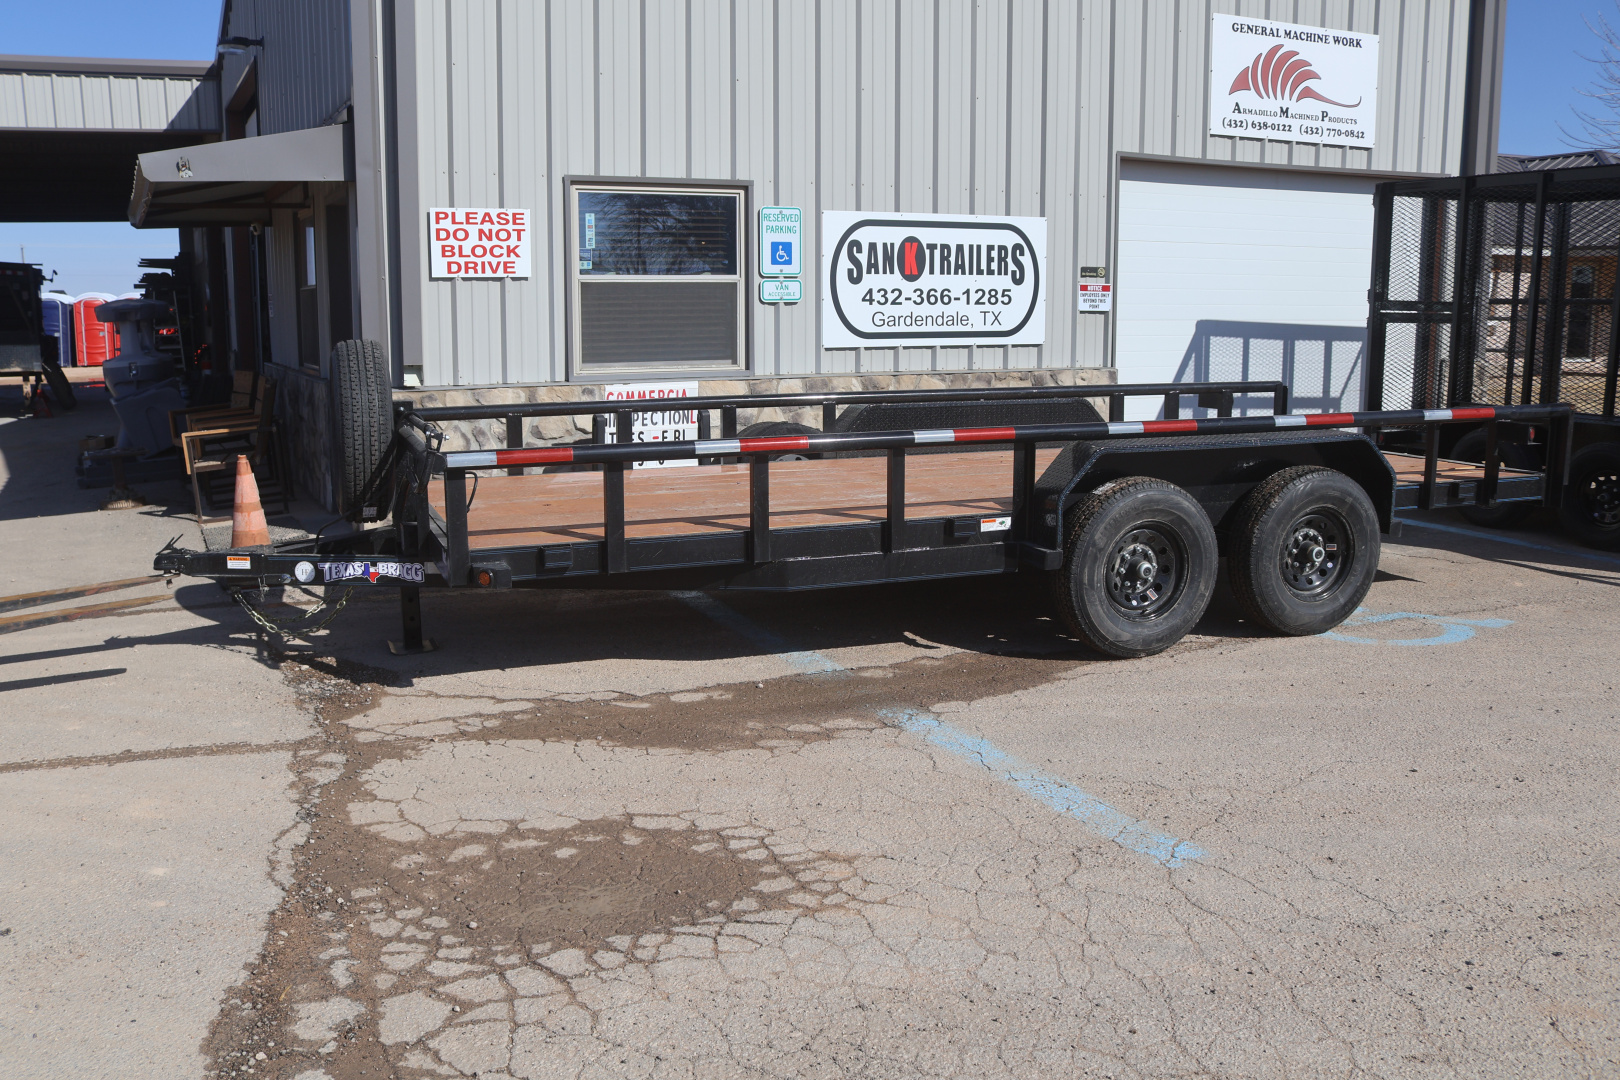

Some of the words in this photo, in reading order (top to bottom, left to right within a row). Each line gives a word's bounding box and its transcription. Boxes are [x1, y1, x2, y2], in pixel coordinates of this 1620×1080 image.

[1231, 22, 1282, 38] GENERAL
[1283, 30, 1330, 45] MACHINE
[1333, 36, 1363, 48] WORK
[1222, 117, 1249, 130] (432)
[1251, 121, 1293, 132] 638-0122
[1299, 124, 1324, 137] (432)
[1326, 128, 1365, 139] 770-0842
[434, 211, 526, 226] PLEASE
[763, 213, 800, 223] RESERVED
[435, 228, 470, 242] DO
[477, 228, 526, 242] NOT
[765, 225, 797, 234] PARKING
[440, 244, 521, 258] BLOCK
[446, 261, 516, 274] DRIVE
[861, 288, 1013, 306] 432-366-1285
[871, 311, 974, 328] Gardendale,
[980, 311, 1002, 326] TX
[317, 562, 364, 582] TEXAS
[376, 562, 425, 583] BRAGG
